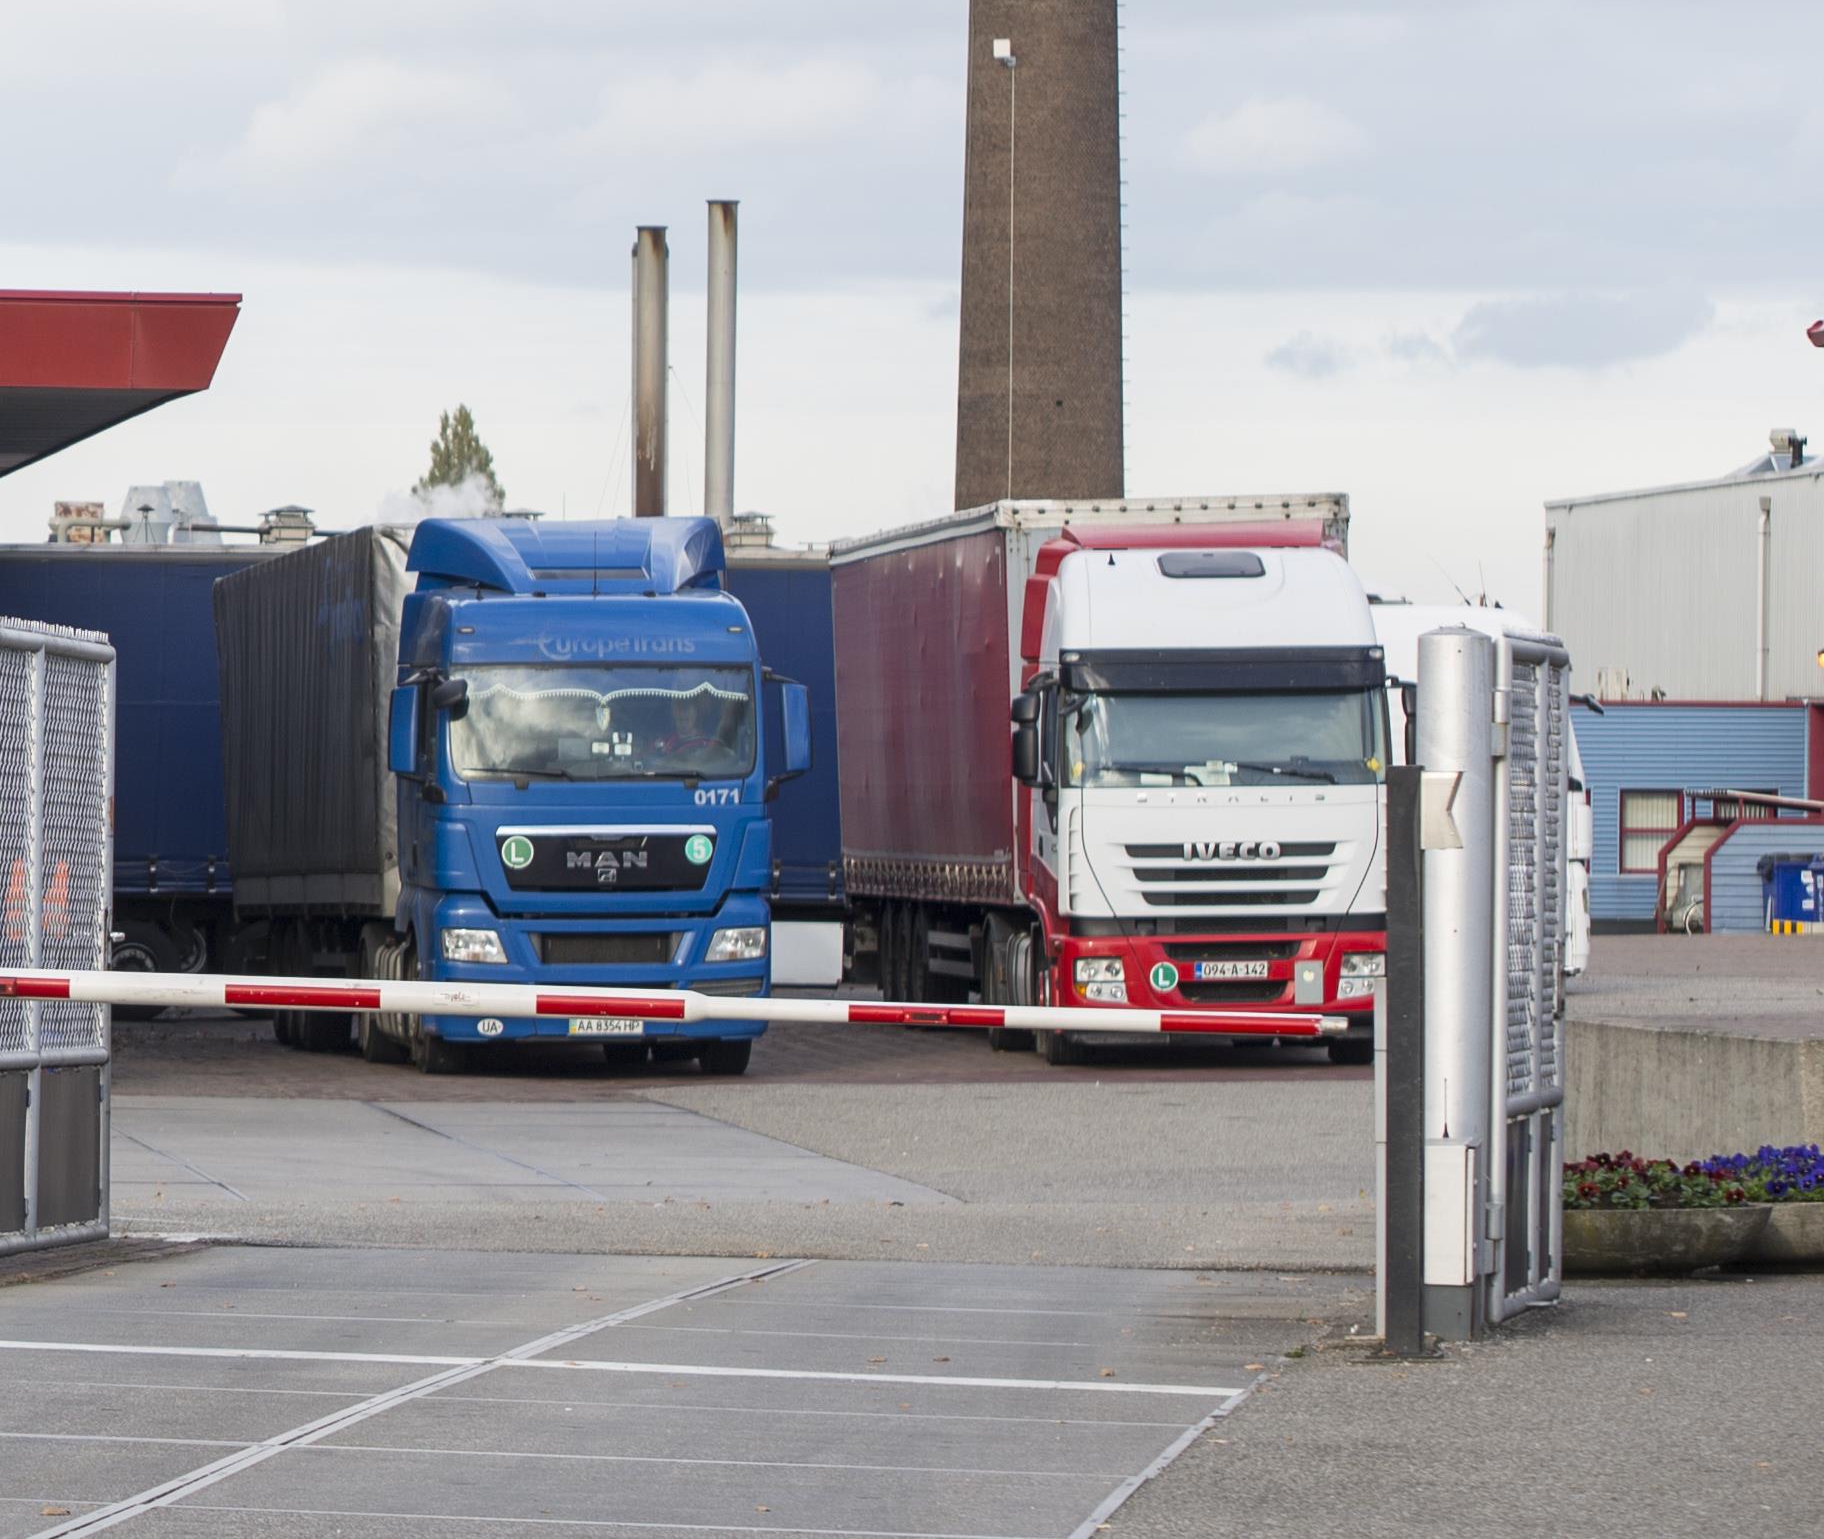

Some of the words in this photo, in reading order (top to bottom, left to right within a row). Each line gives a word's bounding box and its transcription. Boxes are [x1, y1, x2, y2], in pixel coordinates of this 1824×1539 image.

[694, 788, 741, 805] 0171
[511, 842, 525, 863] L
[692, 839, 706, 860] 5
[1183, 842, 1281, 861] IVECO
[566, 851, 648, 869] MAN
[1158, 967, 1171, 986] L
[1203, 963, 1266, 976] 094-A-142
[481, 1019, 499, 1034] UA
[577, 1021, 593, 1032] AA
